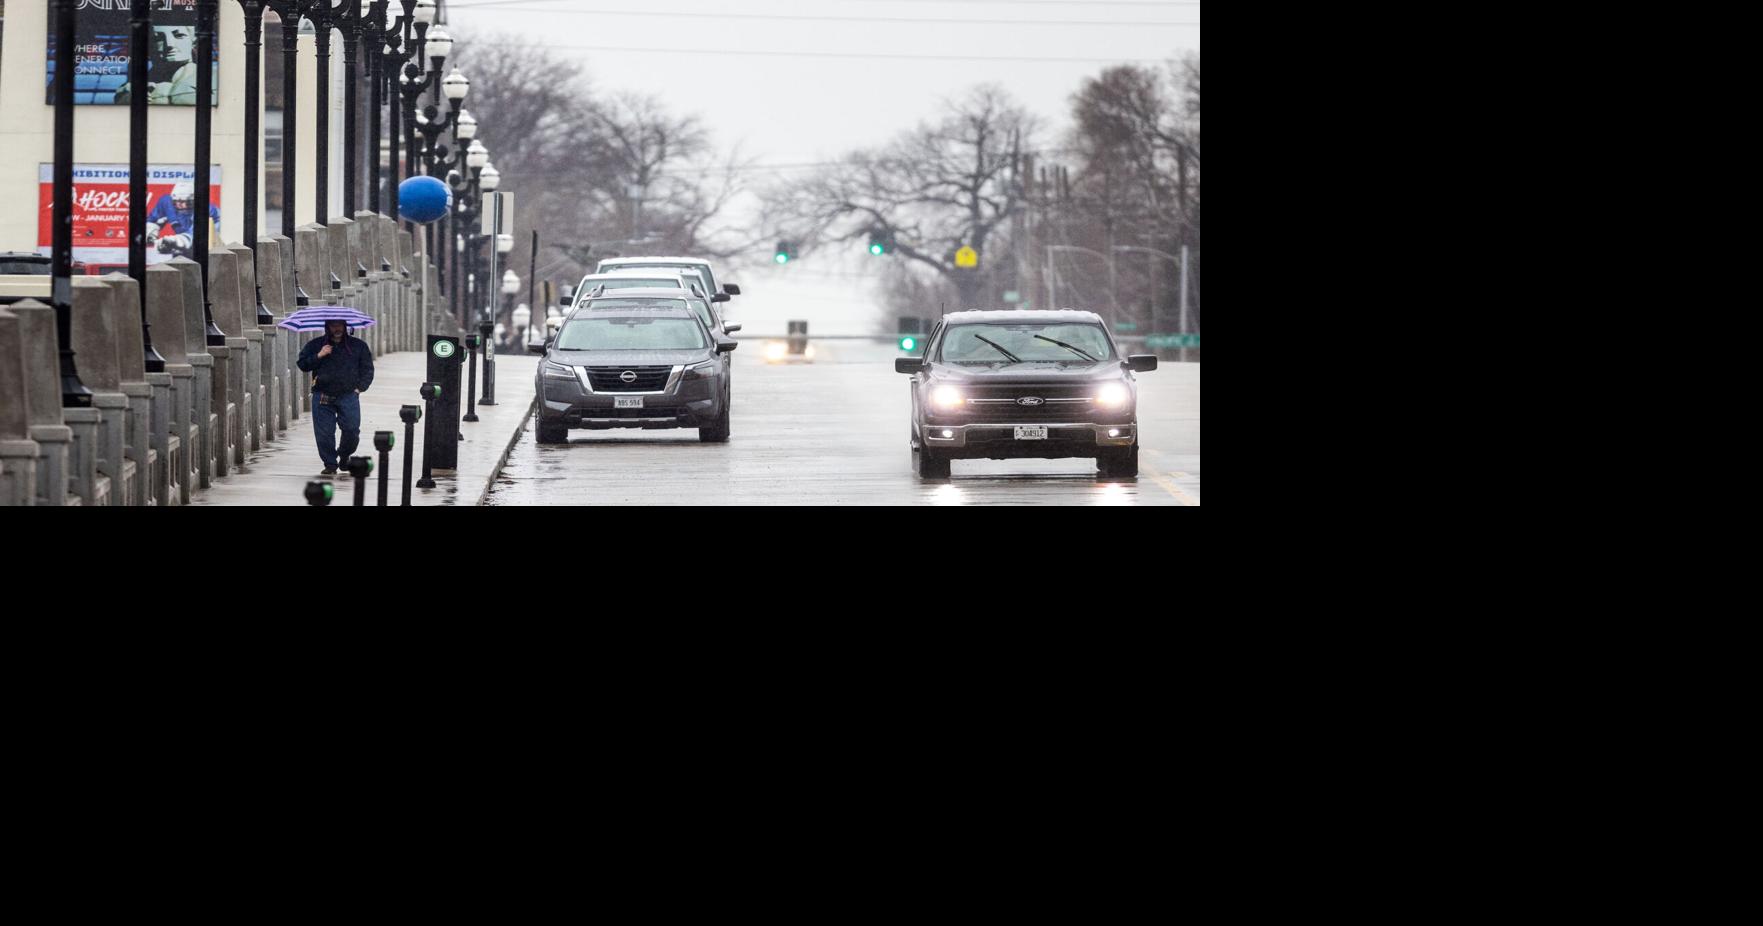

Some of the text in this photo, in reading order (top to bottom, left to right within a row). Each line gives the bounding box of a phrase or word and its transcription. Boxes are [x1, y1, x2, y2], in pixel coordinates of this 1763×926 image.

[75, 55, 131, 64] ENERATIO
[74, 66, 121, 74] ONNECT
[72, 170, 130, 178] HIBITION
[153, 171, 194, 179] DISPL
[85, 214, 125, 222] JANUARY
